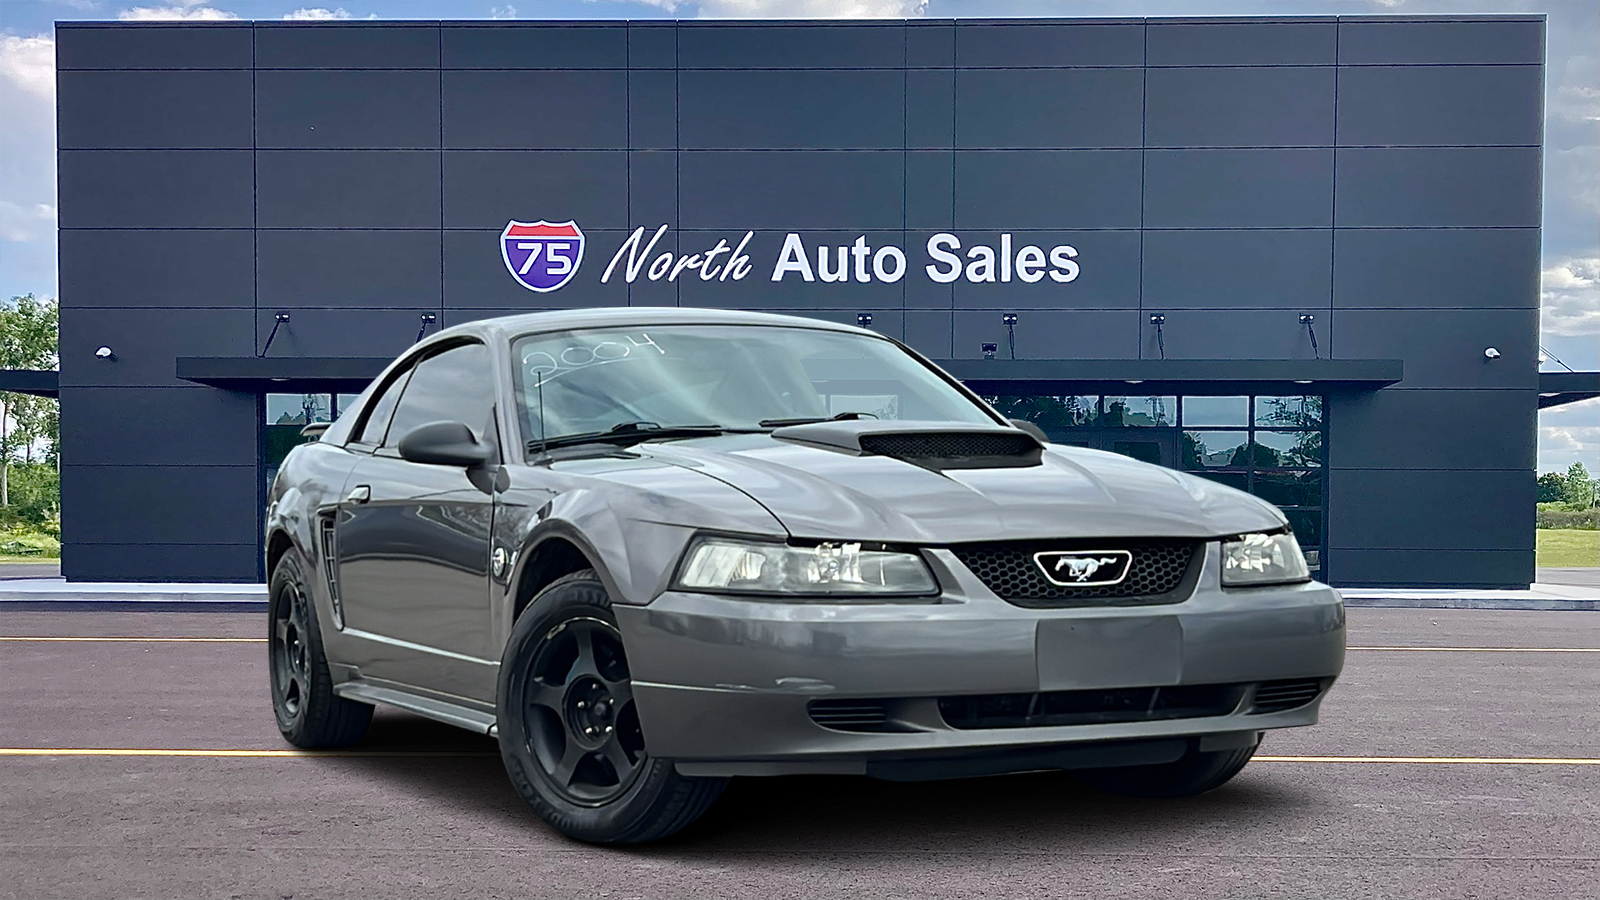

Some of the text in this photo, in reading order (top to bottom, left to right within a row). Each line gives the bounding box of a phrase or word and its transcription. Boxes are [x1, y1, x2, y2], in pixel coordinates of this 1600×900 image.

[516, 224, 1080, 283] 75 North Auto Sales
[523, 333, 665, 376] 2004
